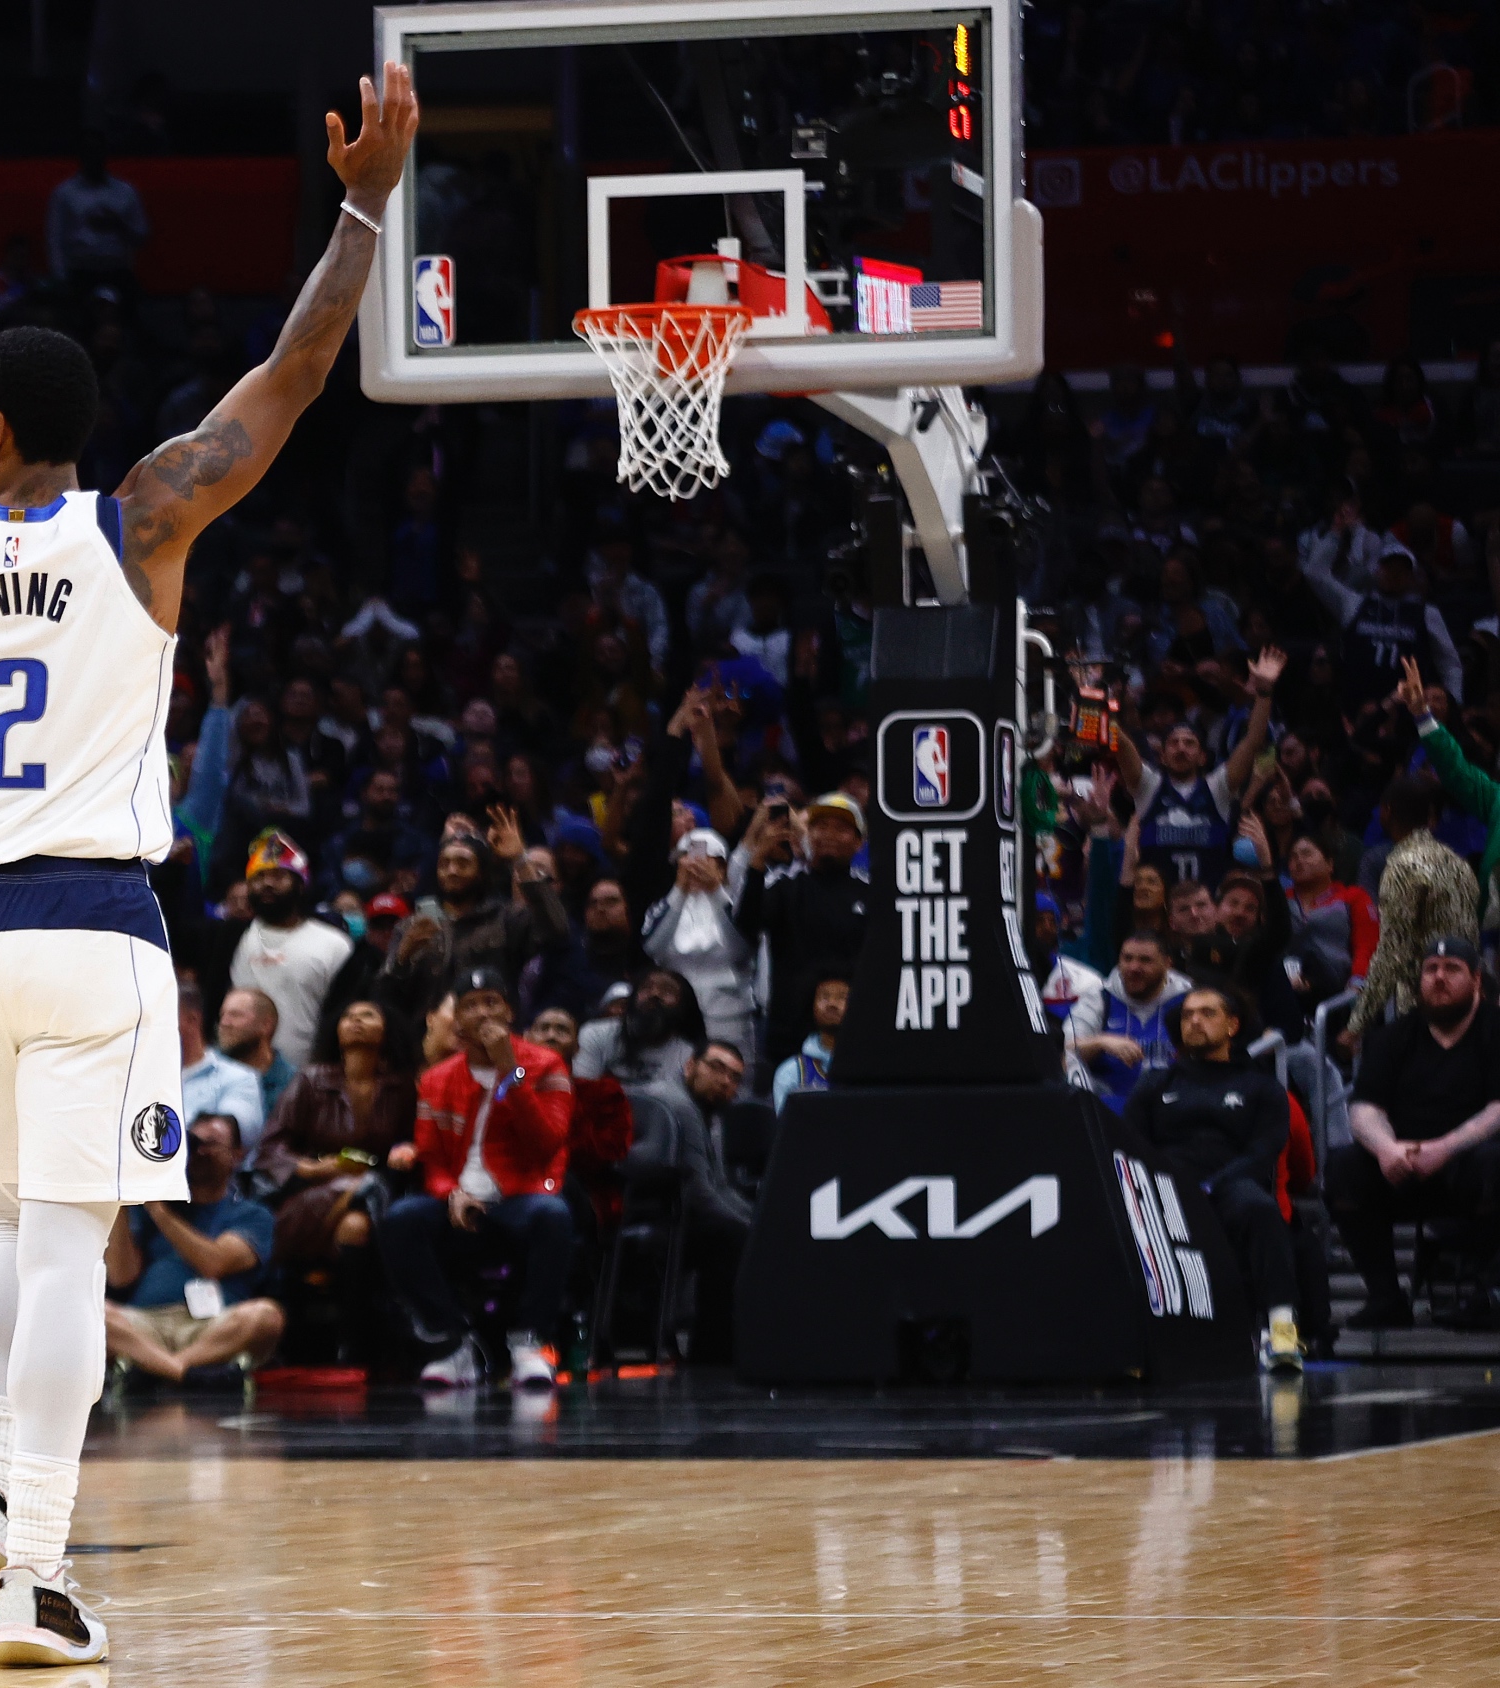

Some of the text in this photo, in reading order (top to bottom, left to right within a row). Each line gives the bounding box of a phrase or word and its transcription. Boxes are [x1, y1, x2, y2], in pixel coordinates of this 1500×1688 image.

[1108, 153, 1399, 199] @LAClippers
[895, 828, 968, 894] GET
[895, 896, 971, 963] THE
[895, 963, 973, 1031] APP
[809, 1174, 1060, 1240] KIA
